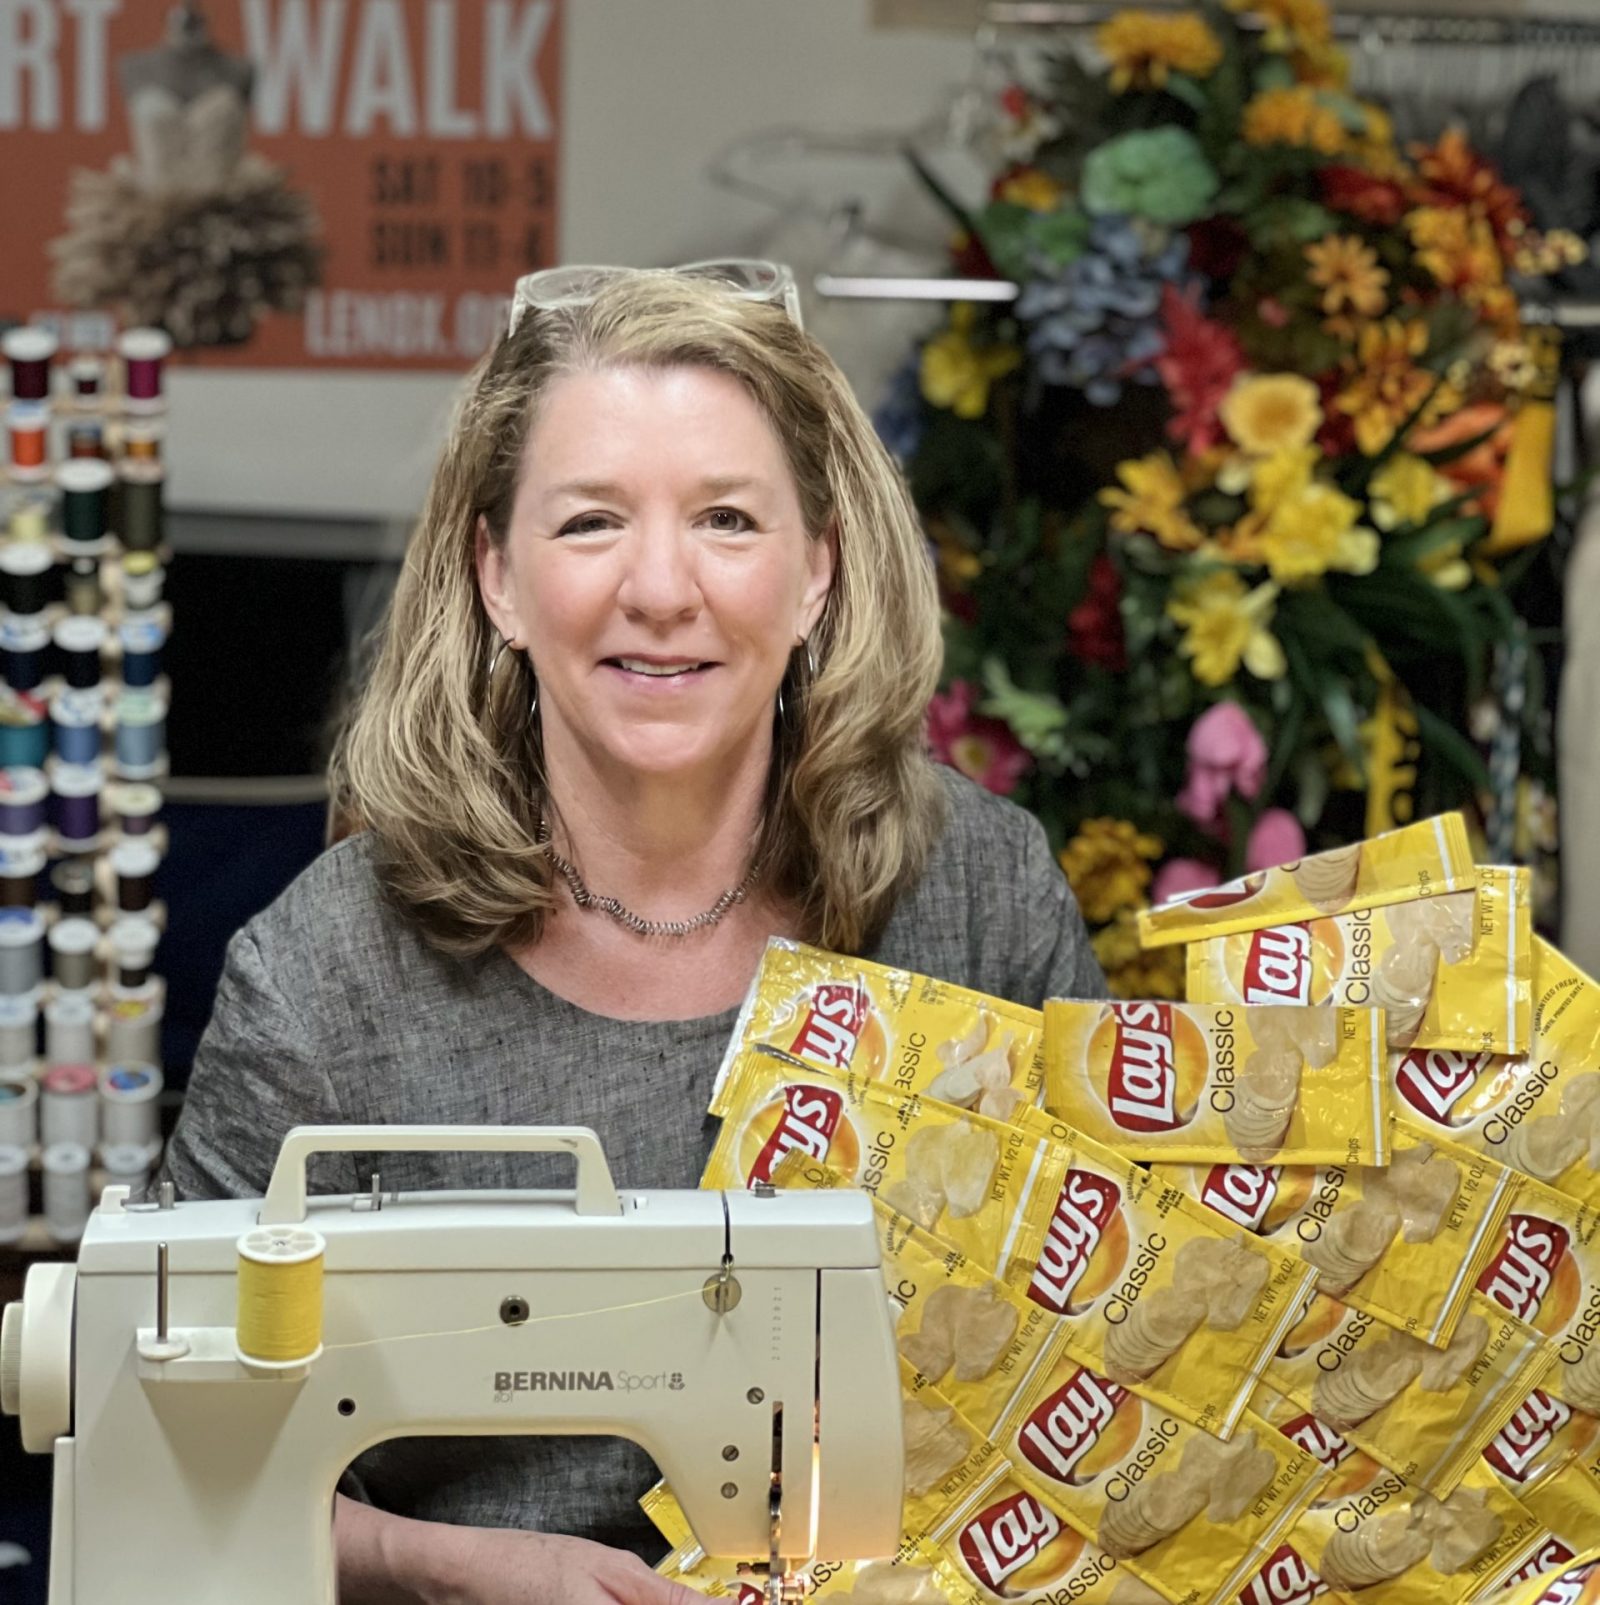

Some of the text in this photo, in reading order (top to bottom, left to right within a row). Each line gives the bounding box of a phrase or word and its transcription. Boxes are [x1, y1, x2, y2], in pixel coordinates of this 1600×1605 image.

[0, 0, 556, 140] RT WALK
[1346, 908, 1372, 1005] Classic
[1481, 915, 1493, 936] NET
[1247, 924, 1312, 1006] Lay
[1534, 977, 1578, 1031] GUARANTEED FRESH
[894, 1032, 926, 1090] assic
[1112, 1002, 1176, 1124] Lay's
[1210, 1009, 1236, 1113] Classic
[1482, 1060, 1559, 1146] Classic
[861, 1131, 896, 1196] assic
[1345, 1137, 1360, 1165] Chips
[990, 1181, 1006, 1202] NET
[1296, 1165, 1348, 1243] Classi
[1446, 1210, 1464, 1232] NET
[1032, 1175, 1105, 1308] Lay's
[1486, 1220, 1553, 1323] ay's
[1103, 1232, 1167, 1325] Classic
[1252, 1302, 1271, 1323] NET
[1316, 1309, 1374, 1372] Class
[494, 1370, 667, 1393] BERNINA Sport
[998, 1354, 1017, 1375] NET
[1465, 1367, 1484, 1388] NET
[1024, 1372, 1120, 1478] Lay
[940, 1478, 959, 1497] NET
[1104, 1418, 1179, 1503] Classic
[1251, 1498, 1270, 1519] NET
[1334, 1474, 1409, 1534] Classi
[968, 1497, 1060, 1586] Lay
[1032, 1553, 1117, 1605] lassic
